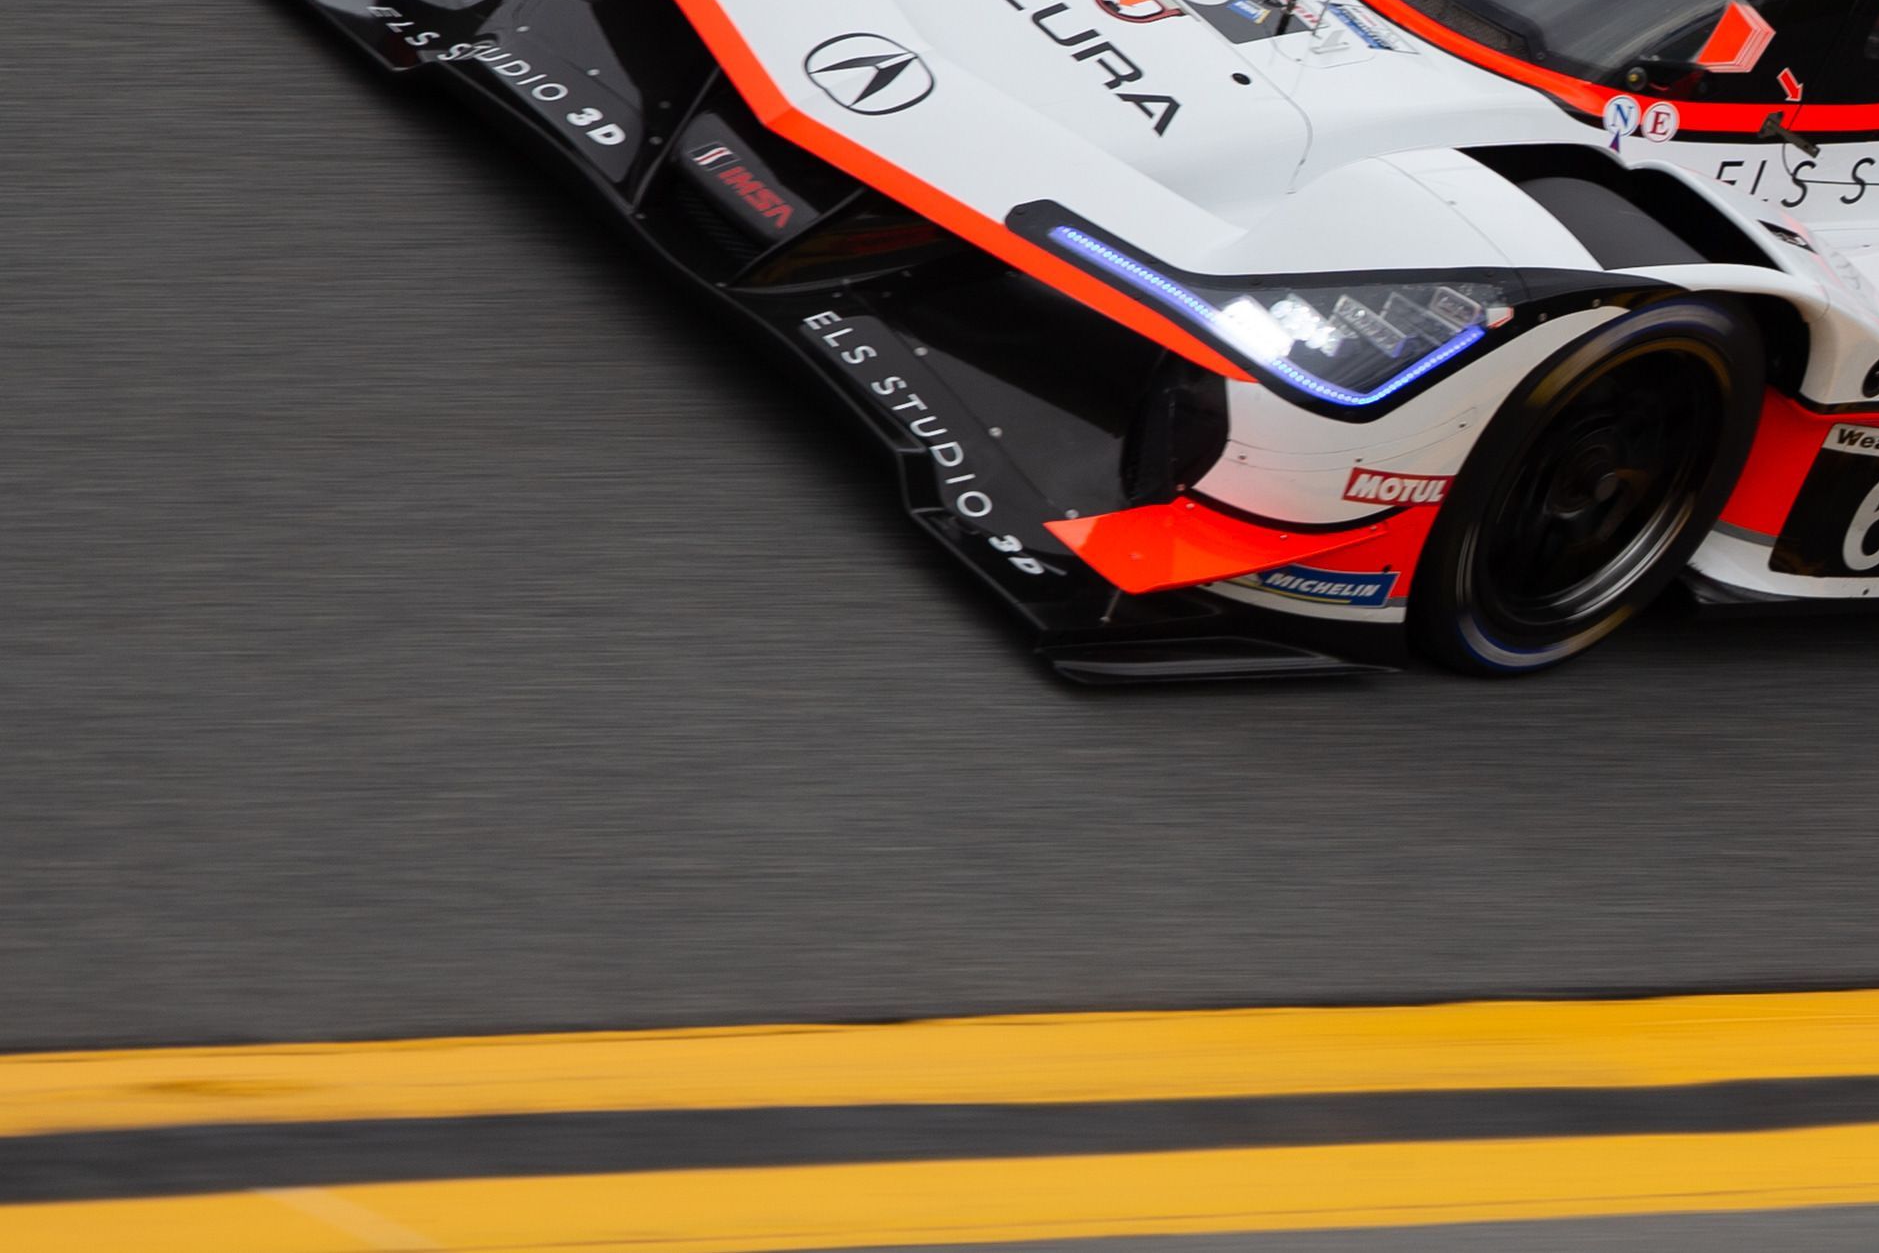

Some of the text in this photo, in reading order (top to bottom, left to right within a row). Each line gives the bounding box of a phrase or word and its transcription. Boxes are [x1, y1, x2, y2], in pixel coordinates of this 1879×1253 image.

[367, 6, 441, 46] ELS
[566, 107, 626, 146] 3D
[1648, 110, 1670, 136] E
[716, 166, 794, 228] IMSA
[803, 311, 1045, 574] ELS STUDIO 3D
[1347, 474, 1447, 503] MOTUL
[1266, 572, 1381, 598] MICHELIN
